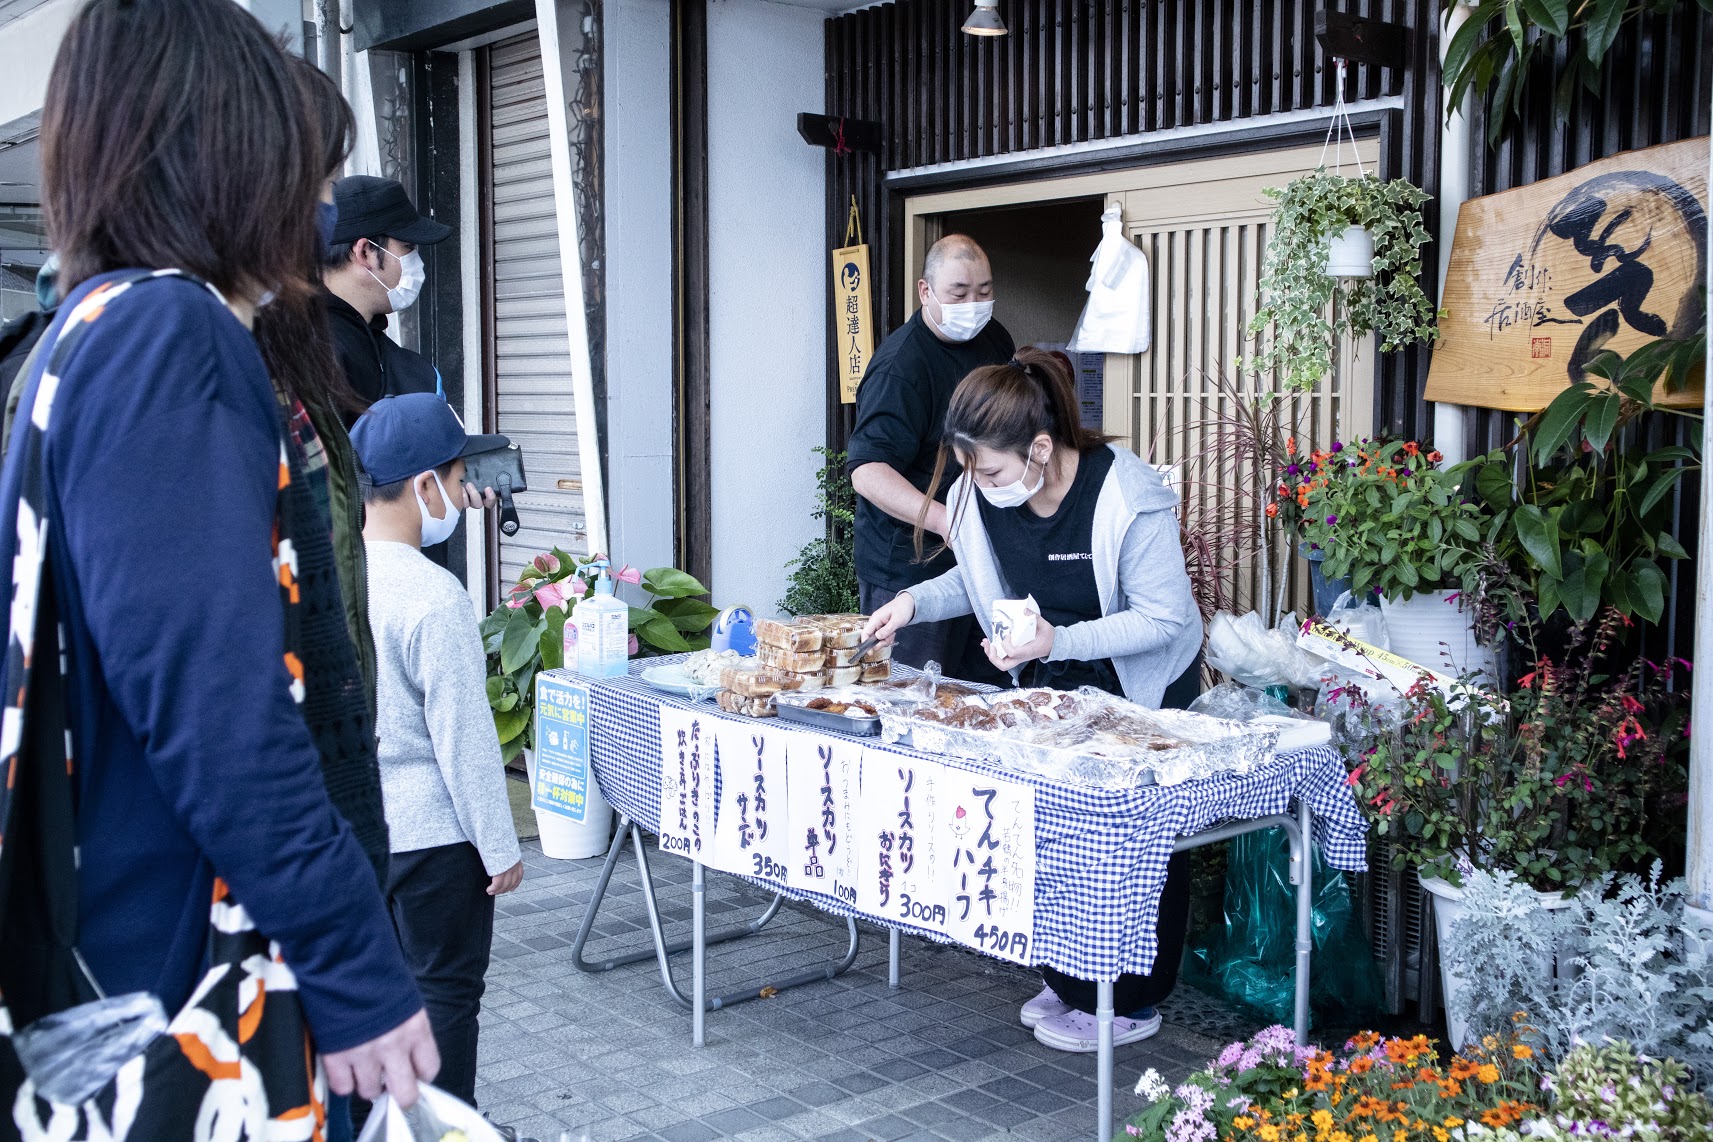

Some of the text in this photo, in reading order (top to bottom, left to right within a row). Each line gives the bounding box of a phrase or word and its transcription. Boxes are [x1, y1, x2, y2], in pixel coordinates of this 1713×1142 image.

[1503, 253, 1552, 296] 創作
[846, 295, 861, 375] 超達人店
[1484, 298, 1583, 344] 居酒屋
[1354, 641, 1375, 656] Wap
[539, 685, 585, 710] 食で活力を!
[540, 702, 585, 726] 元気に営業中
[538, 768, 585, 792] 安全確保の為に
[752, 735, 768, 841] ソースカツ
[818, 745, 836, 855] ソースカツ
[737, 793, 755, 849] サンド
[898, 768, 914, 874] ソースカツ
[662, 833, 691, 854] 200円
[805, 827, 824, 878] 単品
[972, 787, 1000, 916] てんチキ
[752, 853, 788, 882] 350円
[879, 830, 895, 908] おにぎり
[953, 847, 975, 921] ハーフ
[834, 879, 857, 905] 100円
[899, 893, 946, 926] 300円
[973, 923, 1029, 960] 450円
